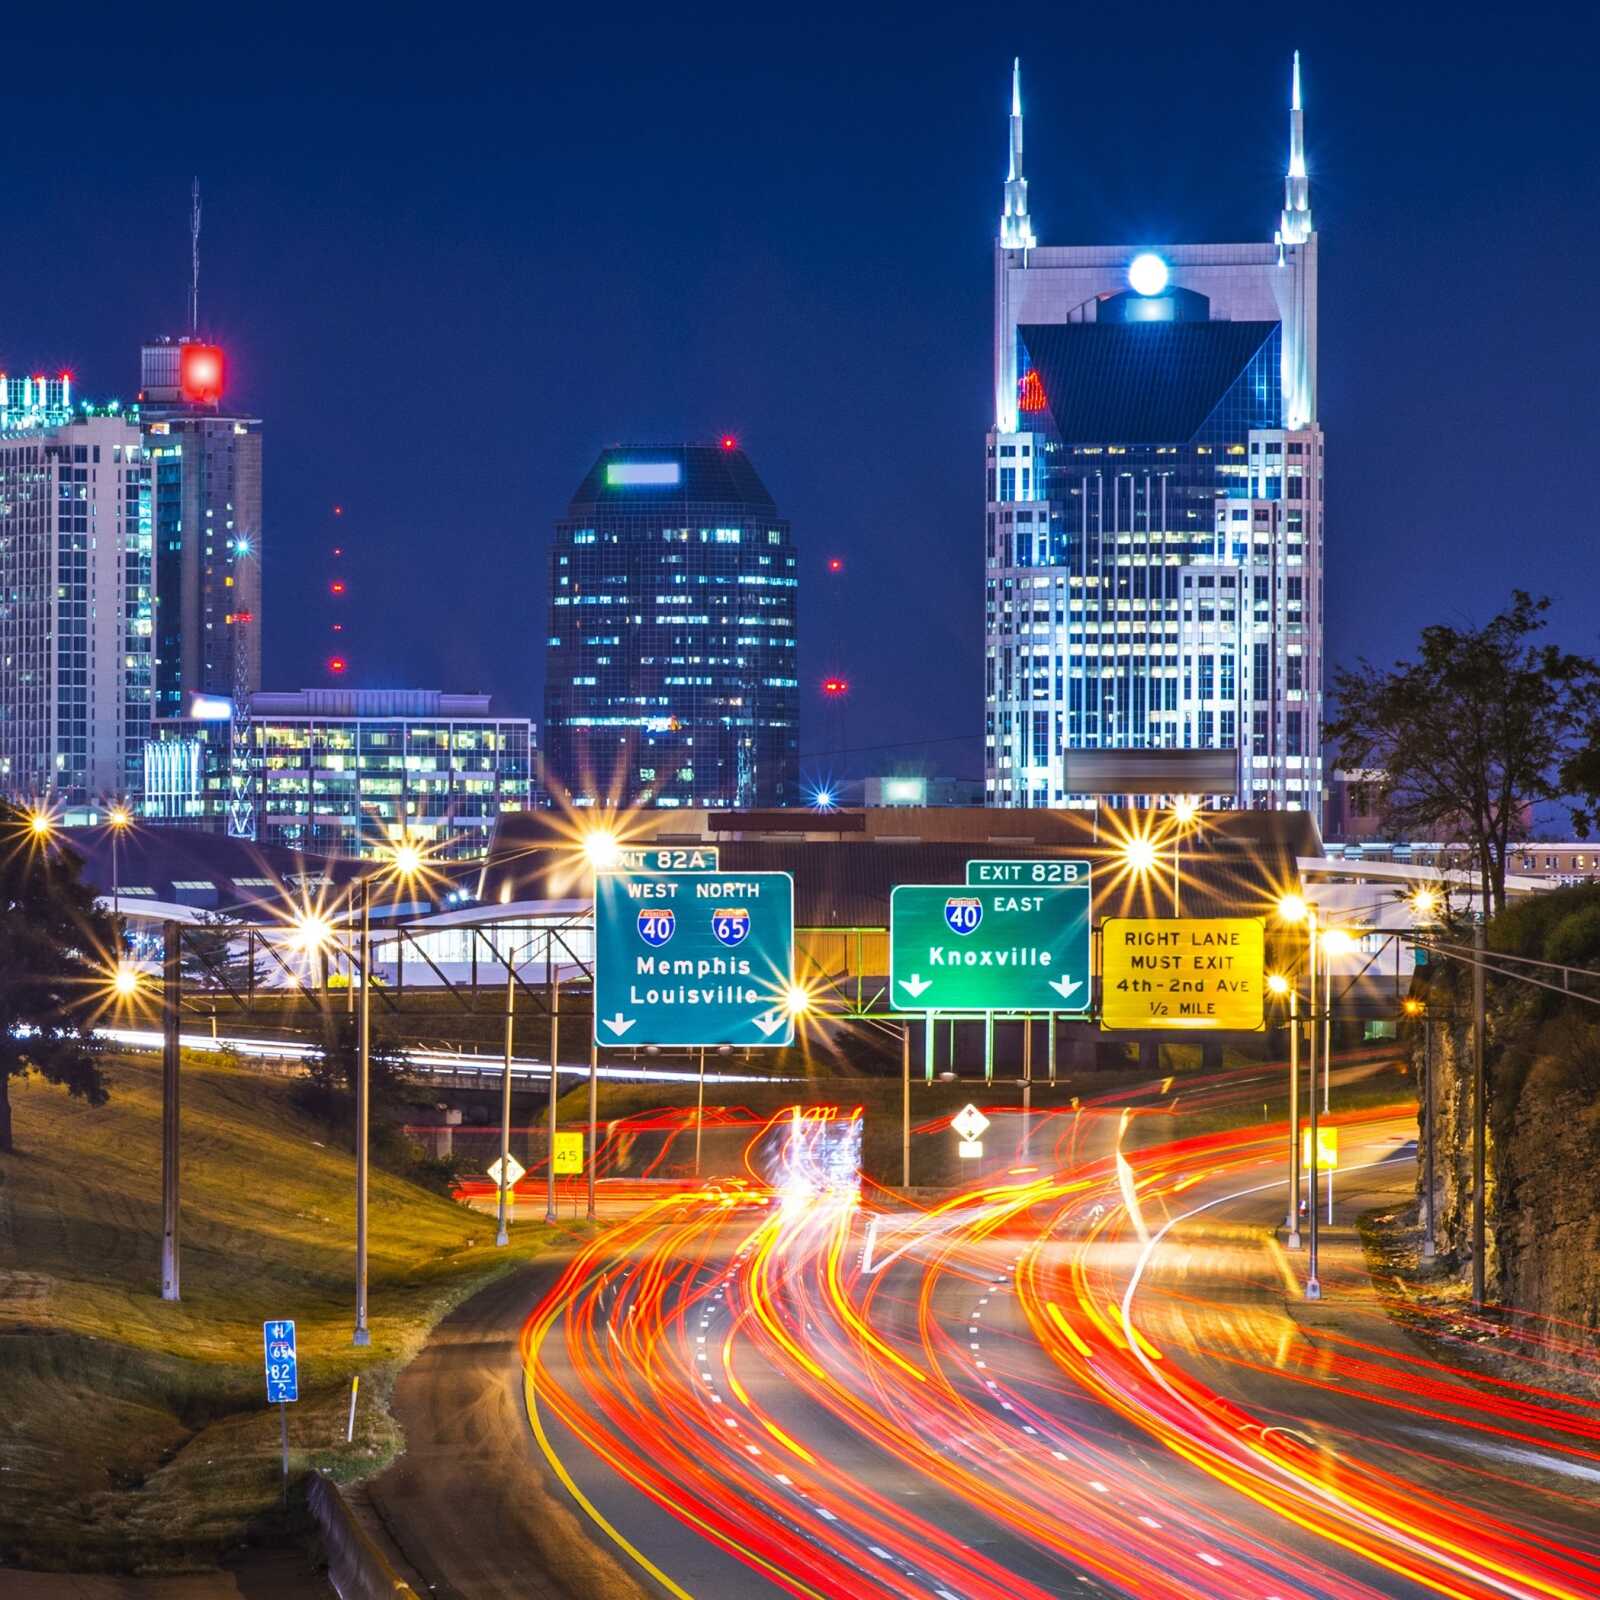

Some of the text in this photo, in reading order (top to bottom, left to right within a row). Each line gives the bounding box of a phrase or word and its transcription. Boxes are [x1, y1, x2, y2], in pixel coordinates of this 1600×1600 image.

[610, 851, 706, 869] XIT 82A
[979, 864, 1078, 882] EXIT 82B
[627, 883, 760, 898] WEST NORTH
[949, 897, 1044, 928] 40 EAST
[643, 919, 744, 939] 40 65
[1125, 932, 1240, 946] RIGHT LANE
[929, 947, 1052, 966] Knoxville
[1131, 956, 1235, 969] MUST EXIT
[636, 956, 751, 979] Memphis
[1216, 979, 1249, 992] AVE
[630, 986, 758, 1004] Louisville
[1179, 1003, 1217, 1015] MILE
[556, 1151, 578, 1162] 45
[273, 1347, 288, 1358] 65
[271, 1364, 290, 1379] 82
